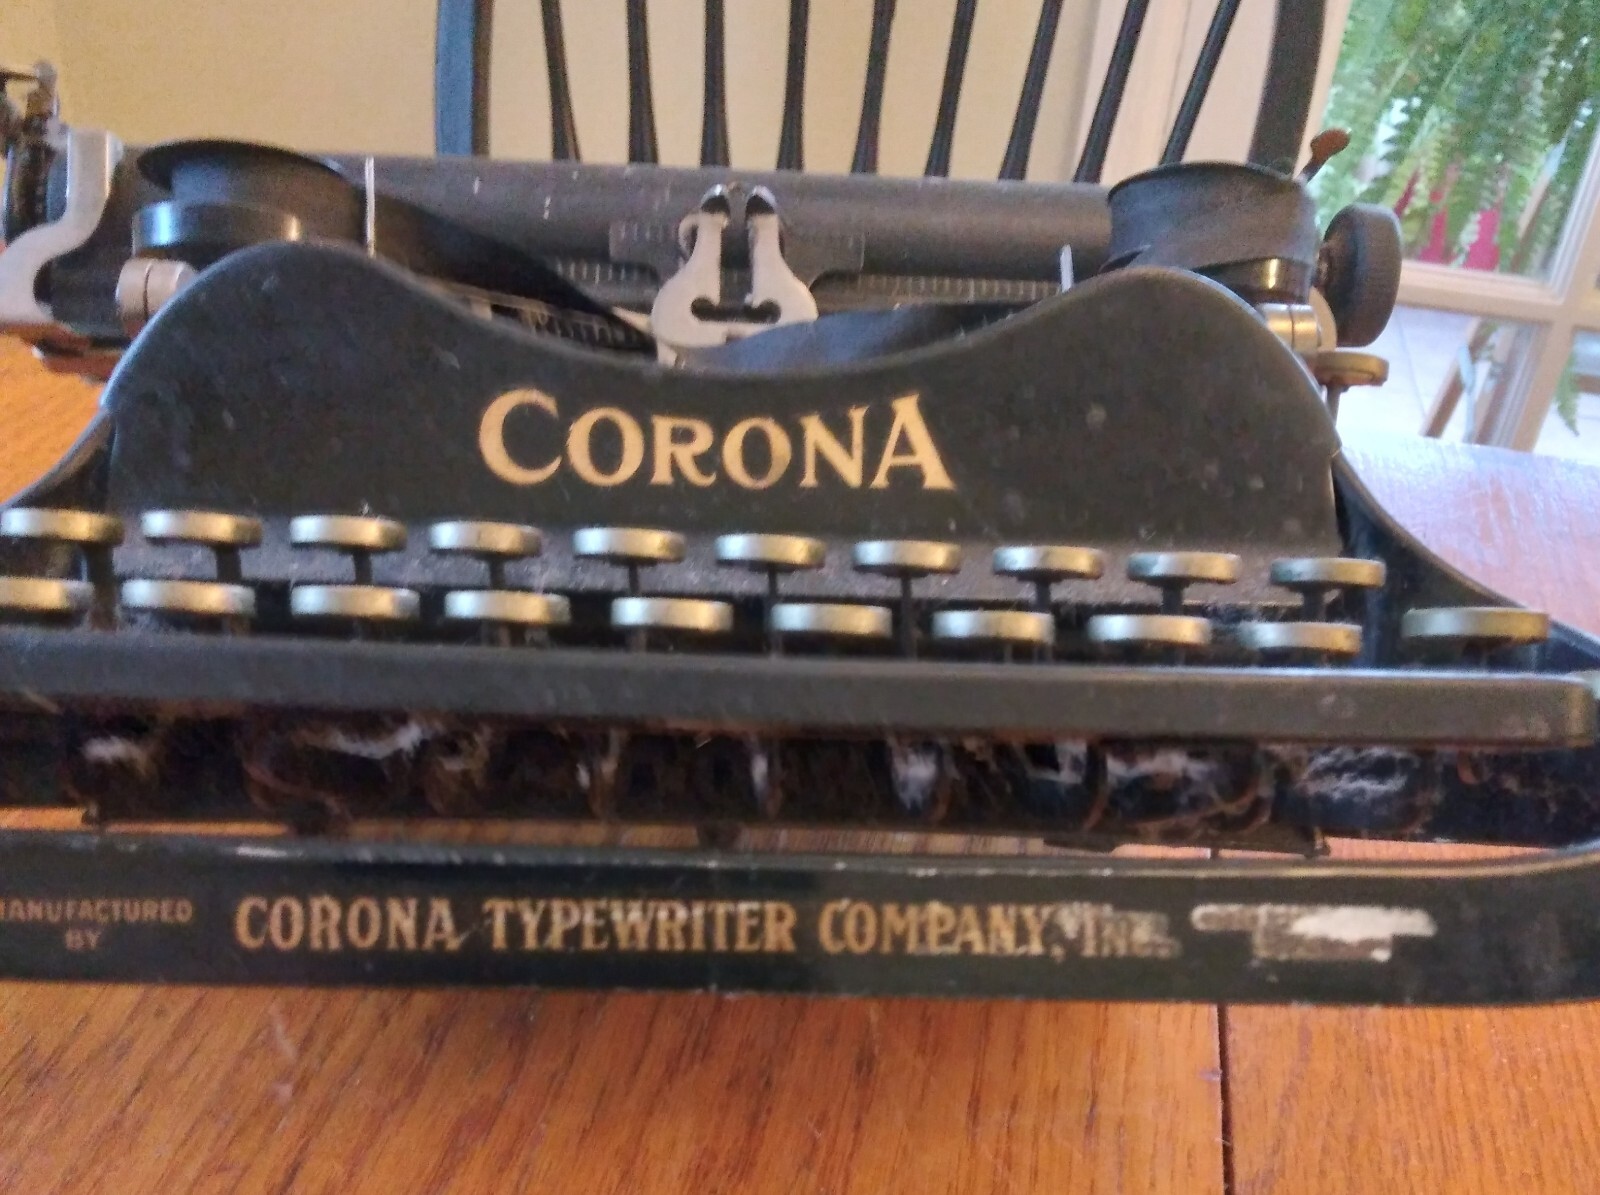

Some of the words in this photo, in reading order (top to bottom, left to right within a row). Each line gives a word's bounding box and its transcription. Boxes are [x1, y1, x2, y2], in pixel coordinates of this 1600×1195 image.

[478, 388, 956, 491] CORONA
[64, 929, 100, 951] BY
[235, 897, 464, 951] CORONA
[482, 897, 797, 951] TYPEWRITER
